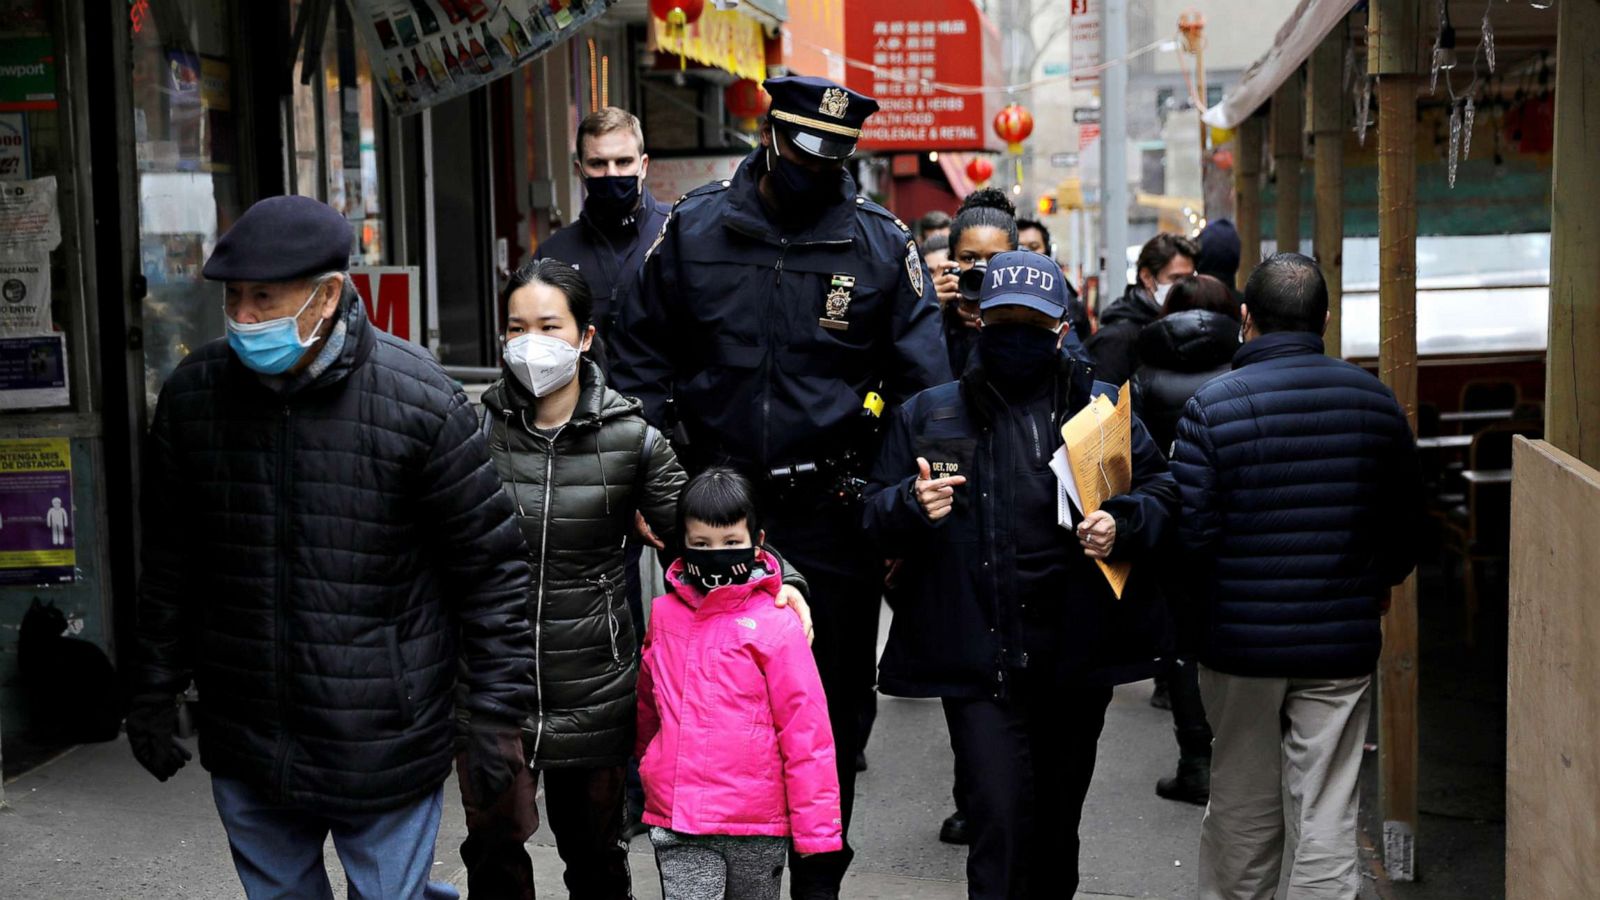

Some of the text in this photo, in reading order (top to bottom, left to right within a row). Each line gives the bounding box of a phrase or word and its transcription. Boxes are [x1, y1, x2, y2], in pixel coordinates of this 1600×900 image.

[915, 98, 925, 111] &
[926, 97, 964, 111] HERBS
[903, 113, 934, 126] FOOD
[862, 125, 977, 141] WHOLESALE & RETAIL
[991, 266, 1054, 291] NYPD
[10, 304, 37, 314] ENTRY
[40, 452, 59, 460] SEIS
[2, 459, 65, 469] DE DISTANCIA
